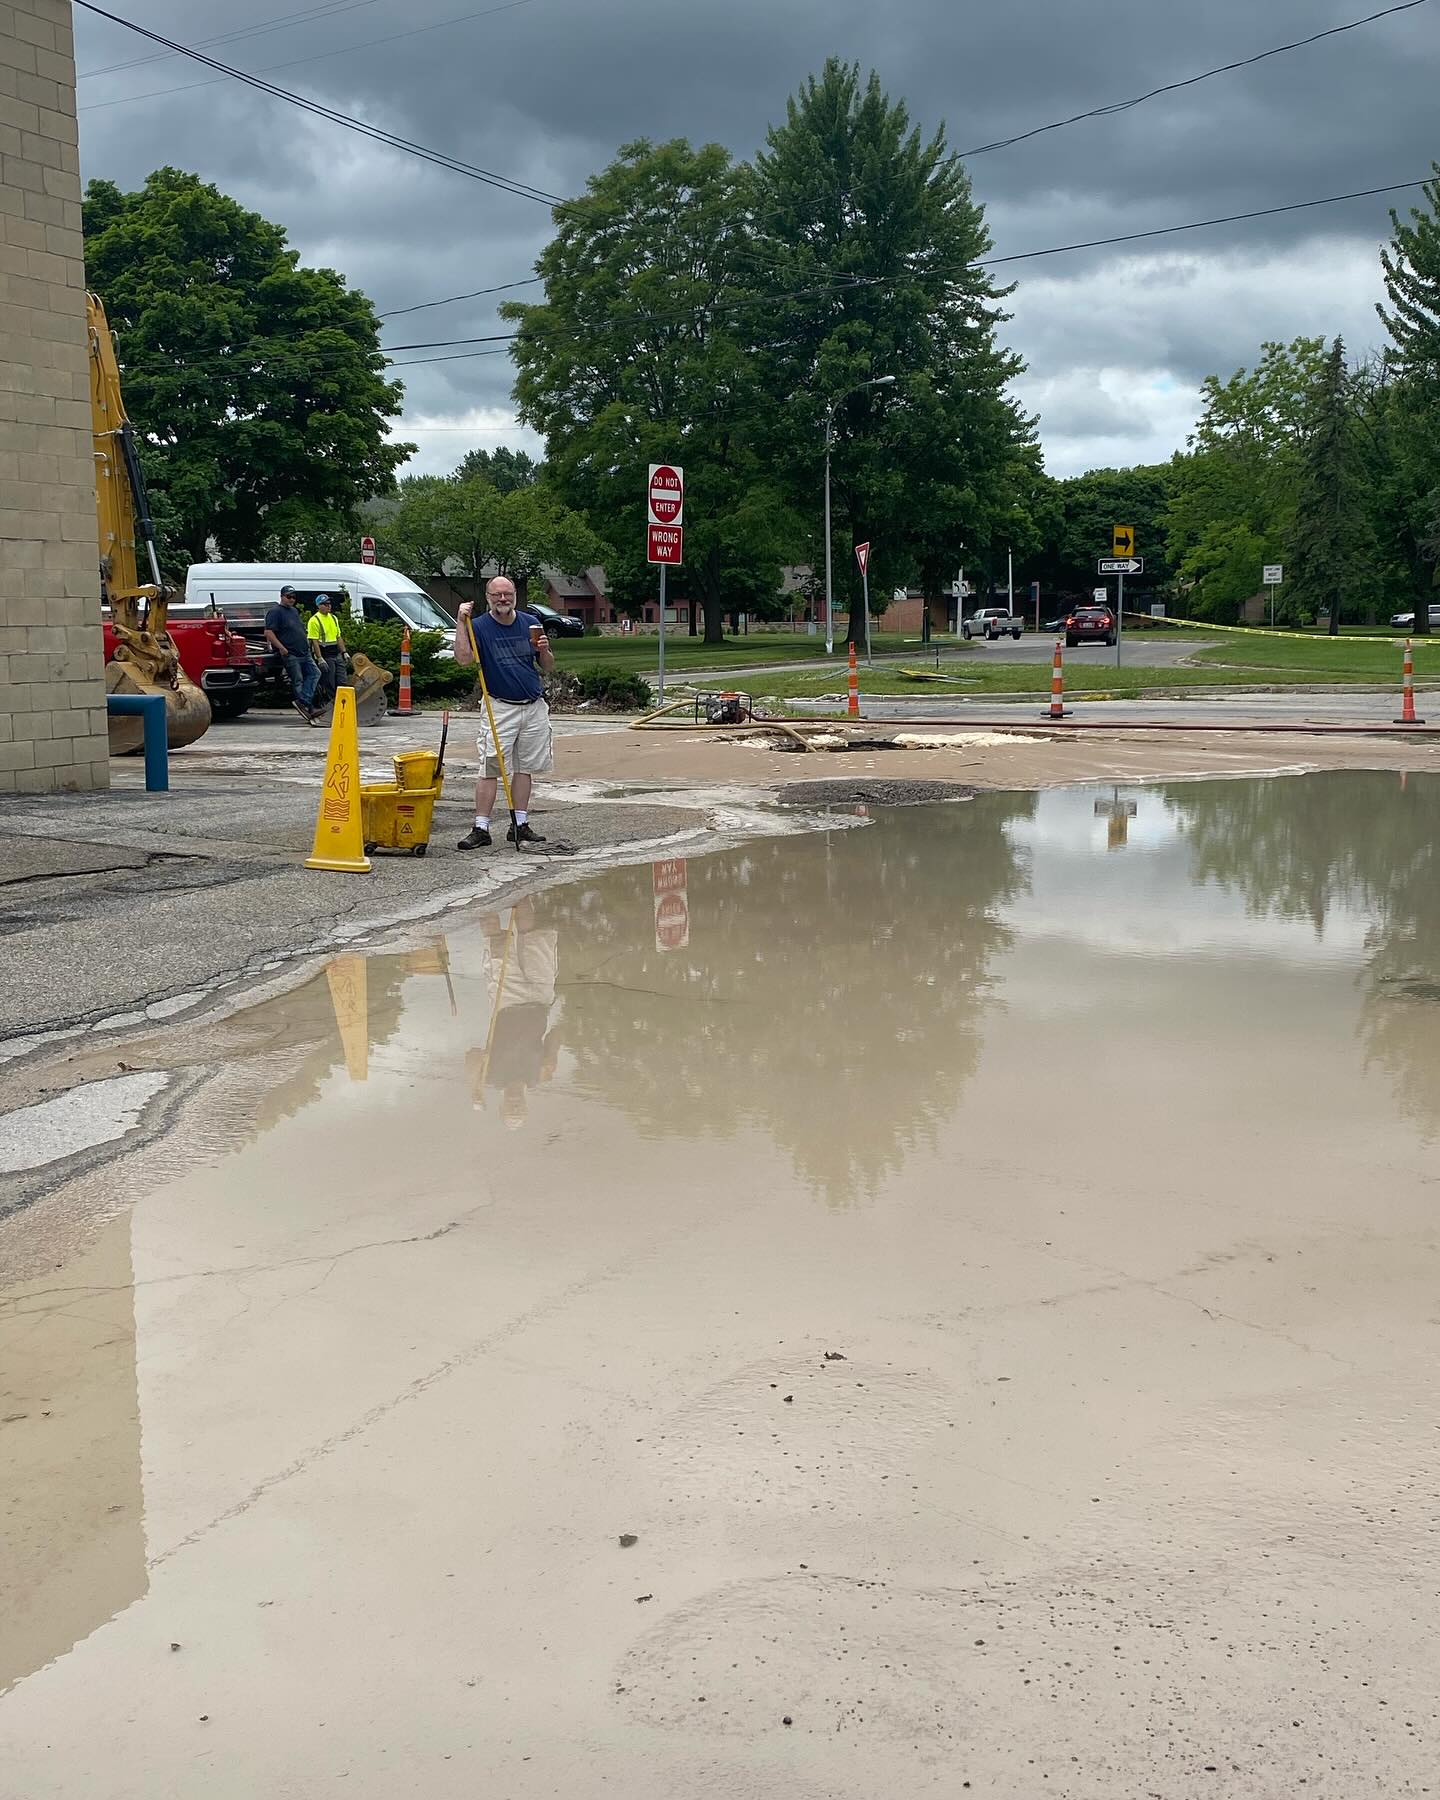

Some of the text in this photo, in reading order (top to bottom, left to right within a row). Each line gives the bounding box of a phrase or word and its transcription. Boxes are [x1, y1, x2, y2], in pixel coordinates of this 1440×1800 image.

[653, 476, 678, 488] DO NOT
[655, 502, 676, 513] ENTER
[652, 531, 679, 544] WRONG
[656, 546, 673, 557] WAY
